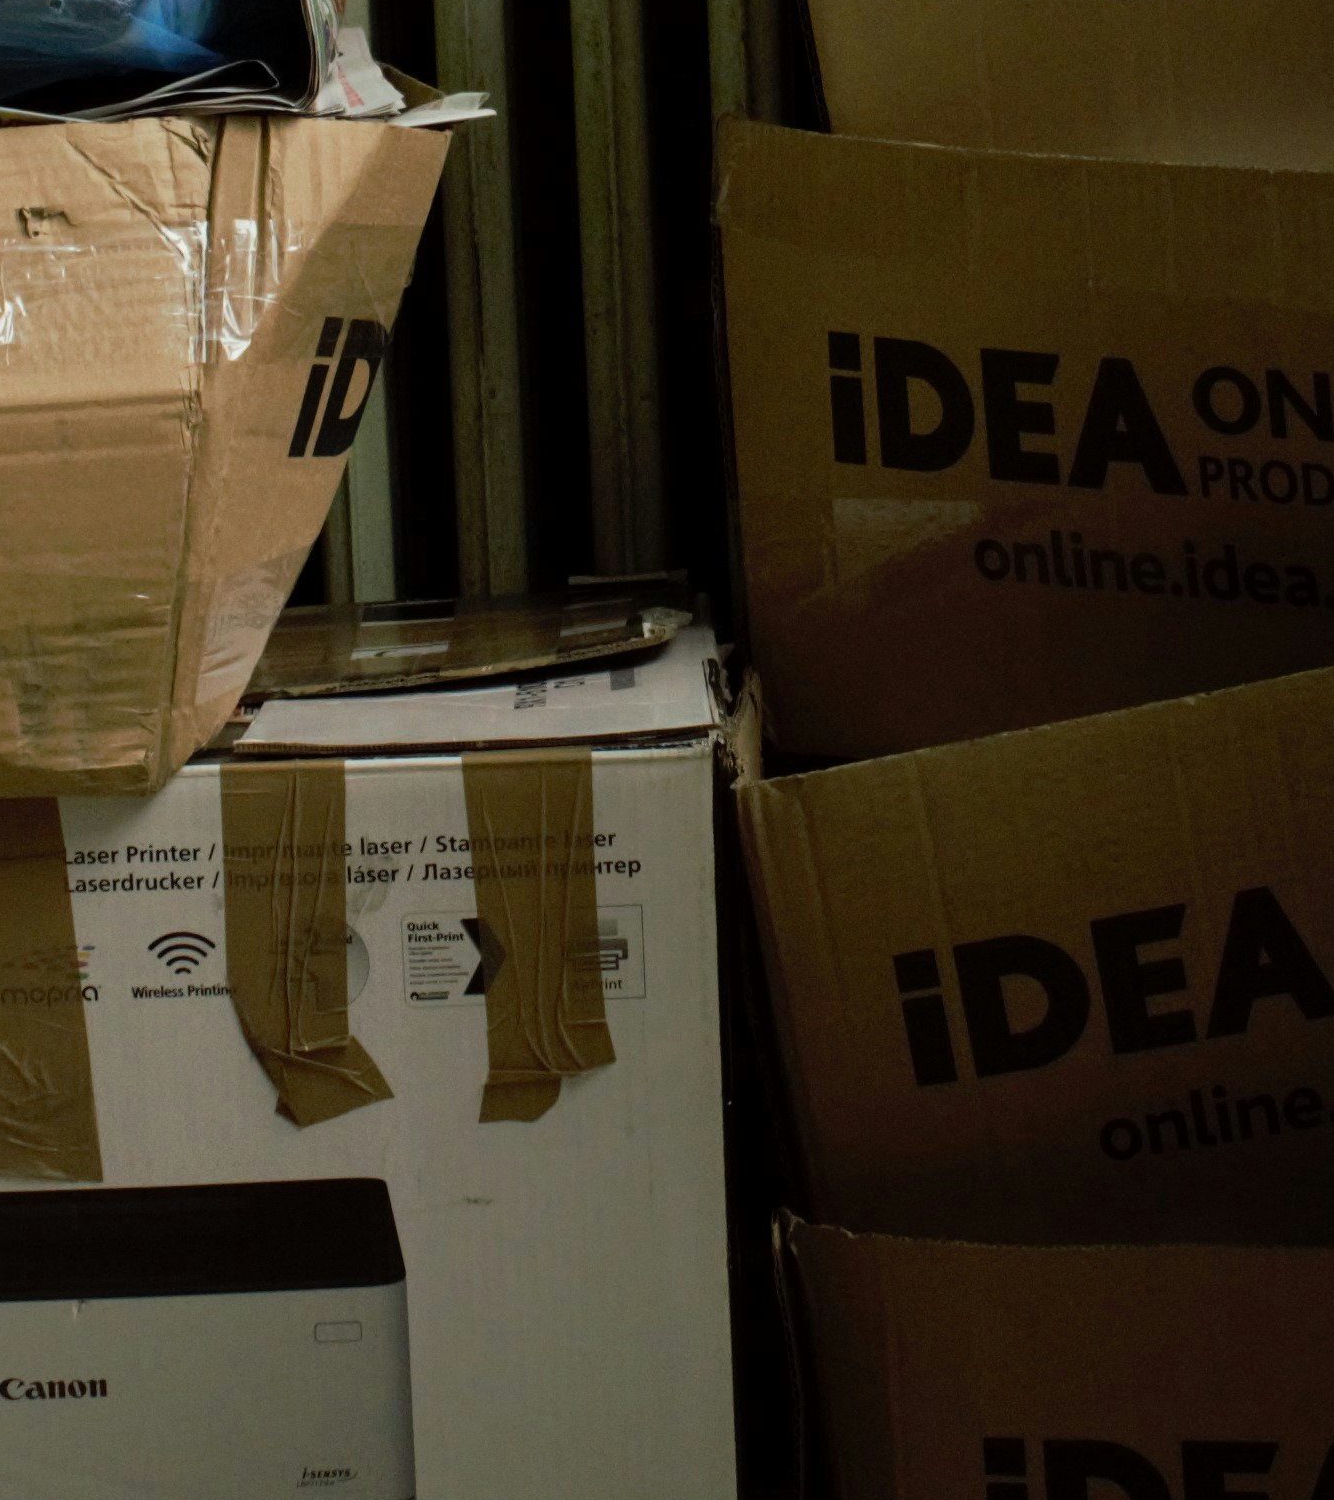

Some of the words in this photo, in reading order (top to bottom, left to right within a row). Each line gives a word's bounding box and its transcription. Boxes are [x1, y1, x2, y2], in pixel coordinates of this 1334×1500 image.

[126, 844, 199, 864] Printer
[360, 835, 413, 855] laser
[347, 864, 400, 884] láser
[407, 921, 439, 932] Quick
[407, 932, 465, 943] First-Print
[131, 985, 184, 1000] Wireless
